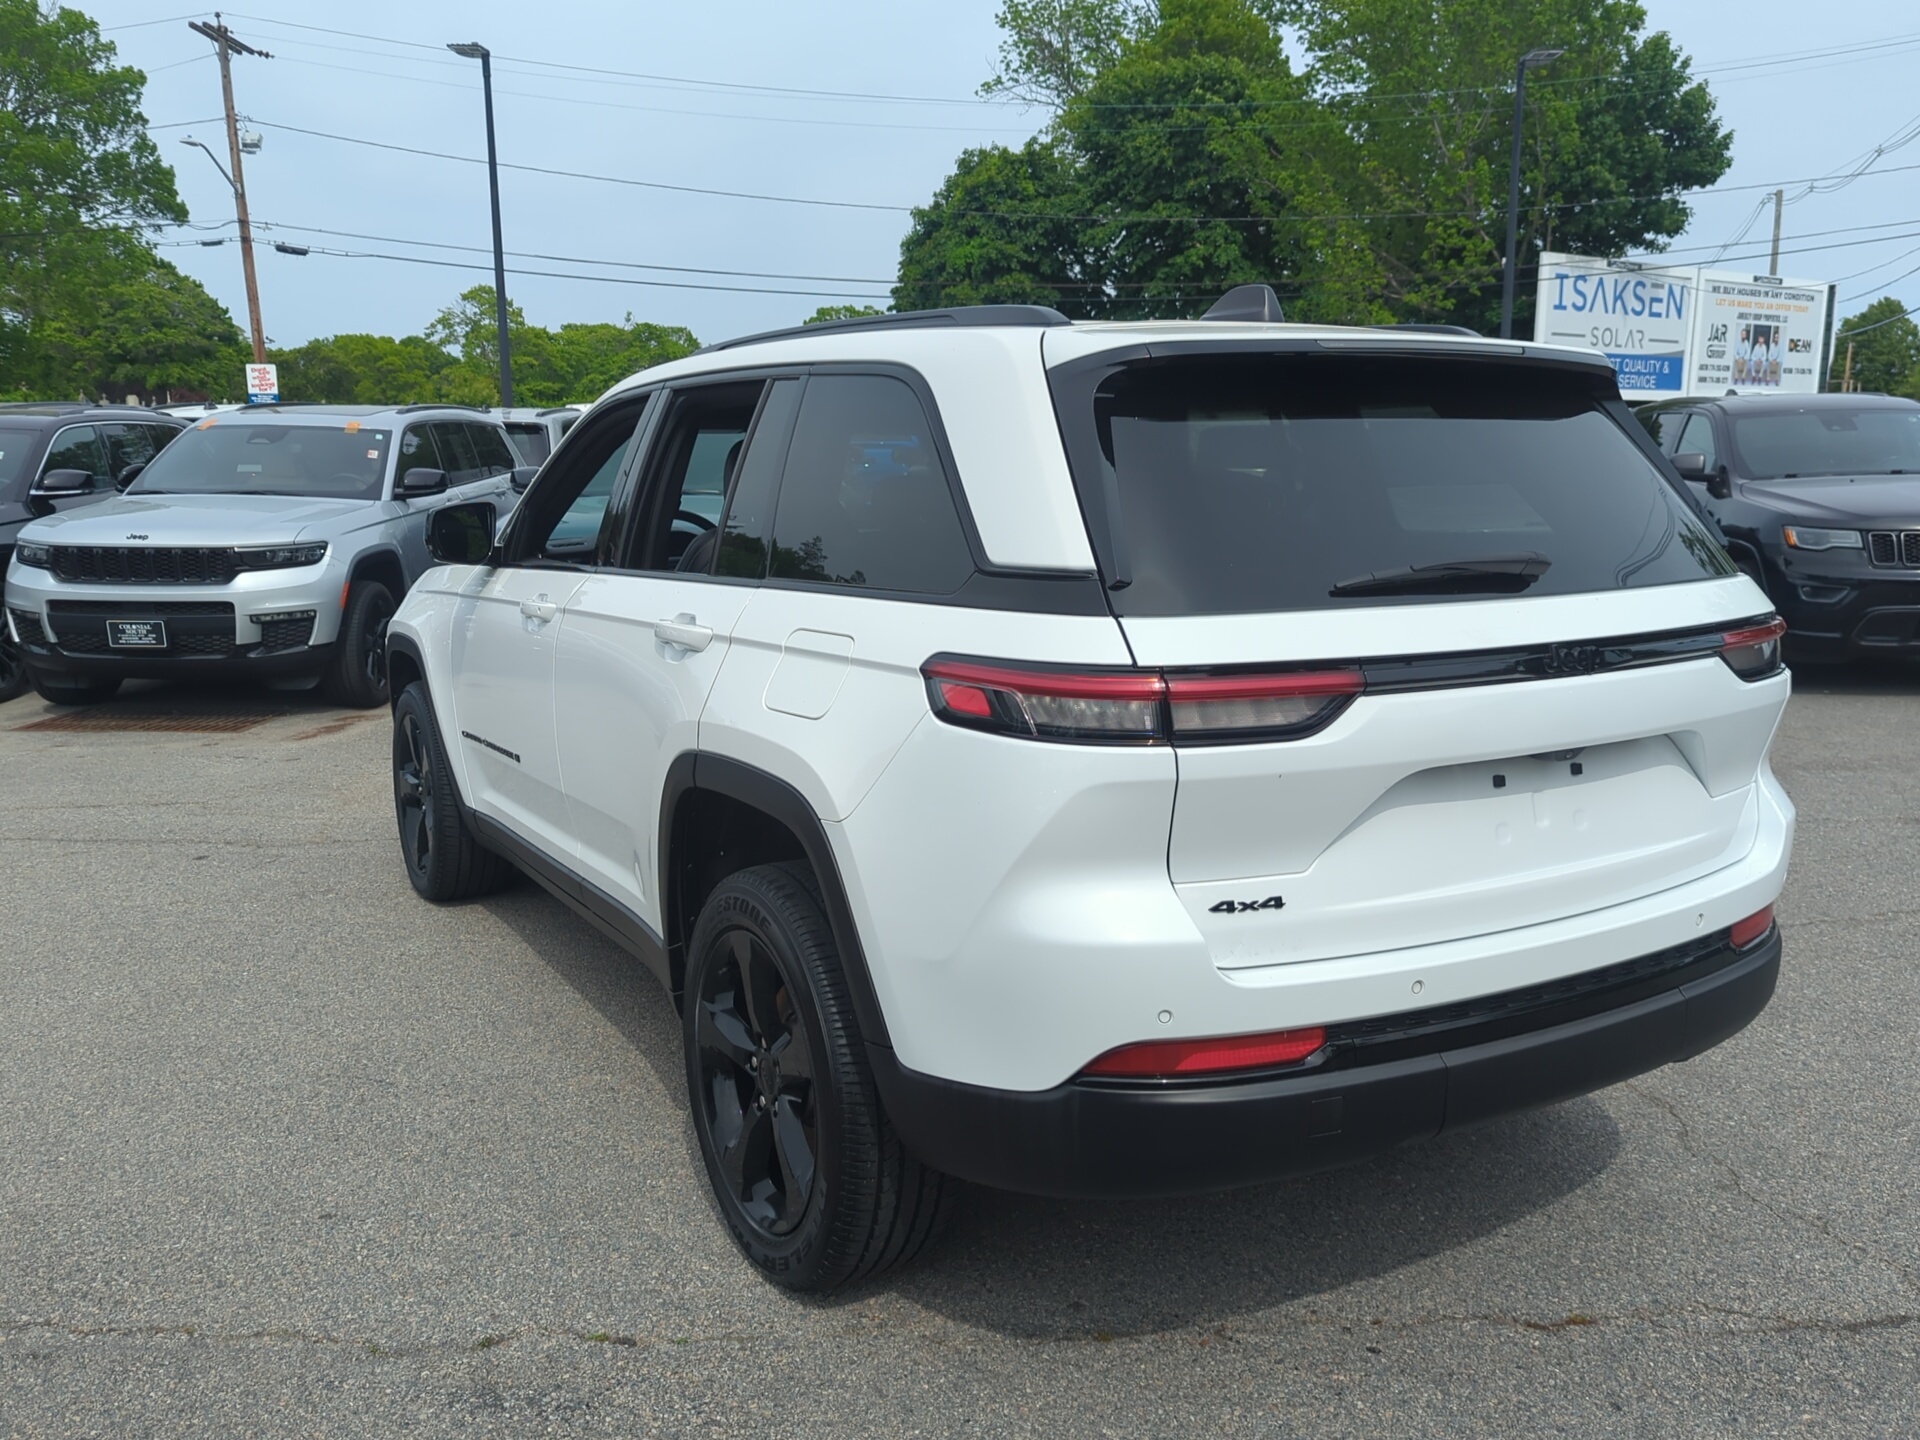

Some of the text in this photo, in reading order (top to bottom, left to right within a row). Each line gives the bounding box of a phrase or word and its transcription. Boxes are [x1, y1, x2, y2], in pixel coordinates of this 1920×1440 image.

[1553, 272, 1686, 320] ISAKSEN
[1712, 285, 1815, 302] WE BUY HOUSES IN ANY CONDITION
[1590, 326, 1645, 349] SOLAR
[1708, 323, 1728, 343] JAR
[1623, 358, 1661, 373] QUALITY
[1662, 361, 1670, 374] &
[1618, 374, 1657, 389] SERVICE
[126, 532, 149, 541] Jeep
[1543, 643, 1601, 676] Jeep
[1207, 895, 1287, 914] 4x4
